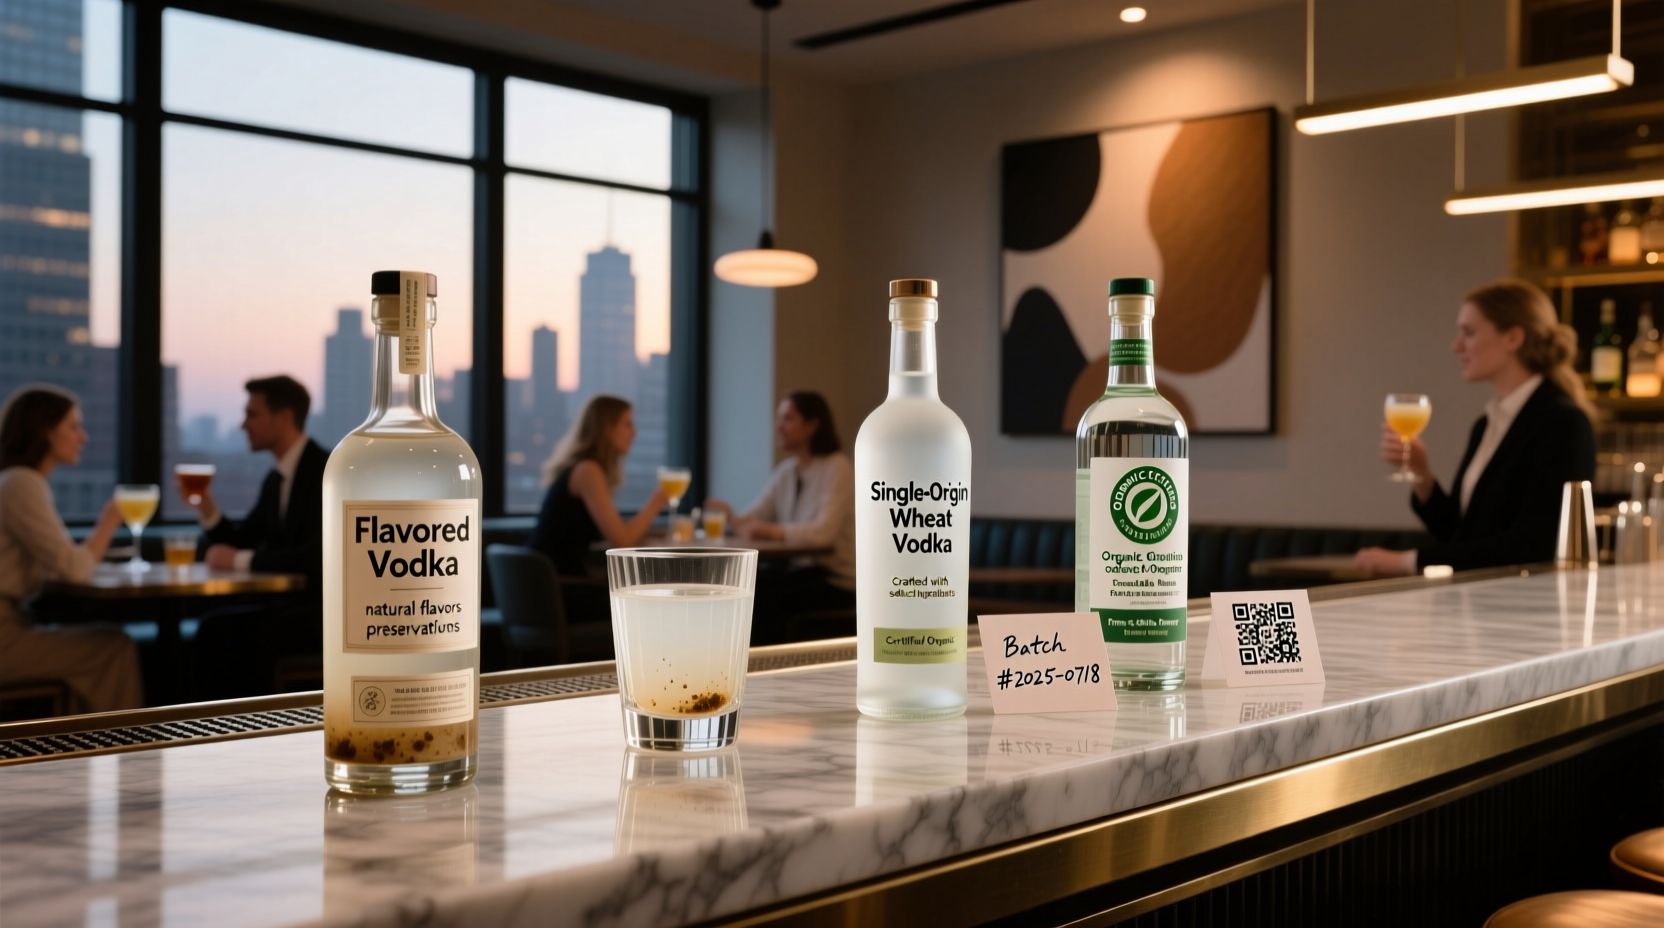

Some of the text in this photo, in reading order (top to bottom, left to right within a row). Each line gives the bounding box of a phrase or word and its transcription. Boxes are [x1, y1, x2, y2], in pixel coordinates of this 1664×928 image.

[355, 515, 470, 544] Flavored
[889, 507, 953, 528] Wheat
[892, 532, 952, 554] Vodka
[367, 548, 459, 578] Vodka
[365, 599, 463, 617] natural flavors
[1003, 631, 1067, 658] Batch
